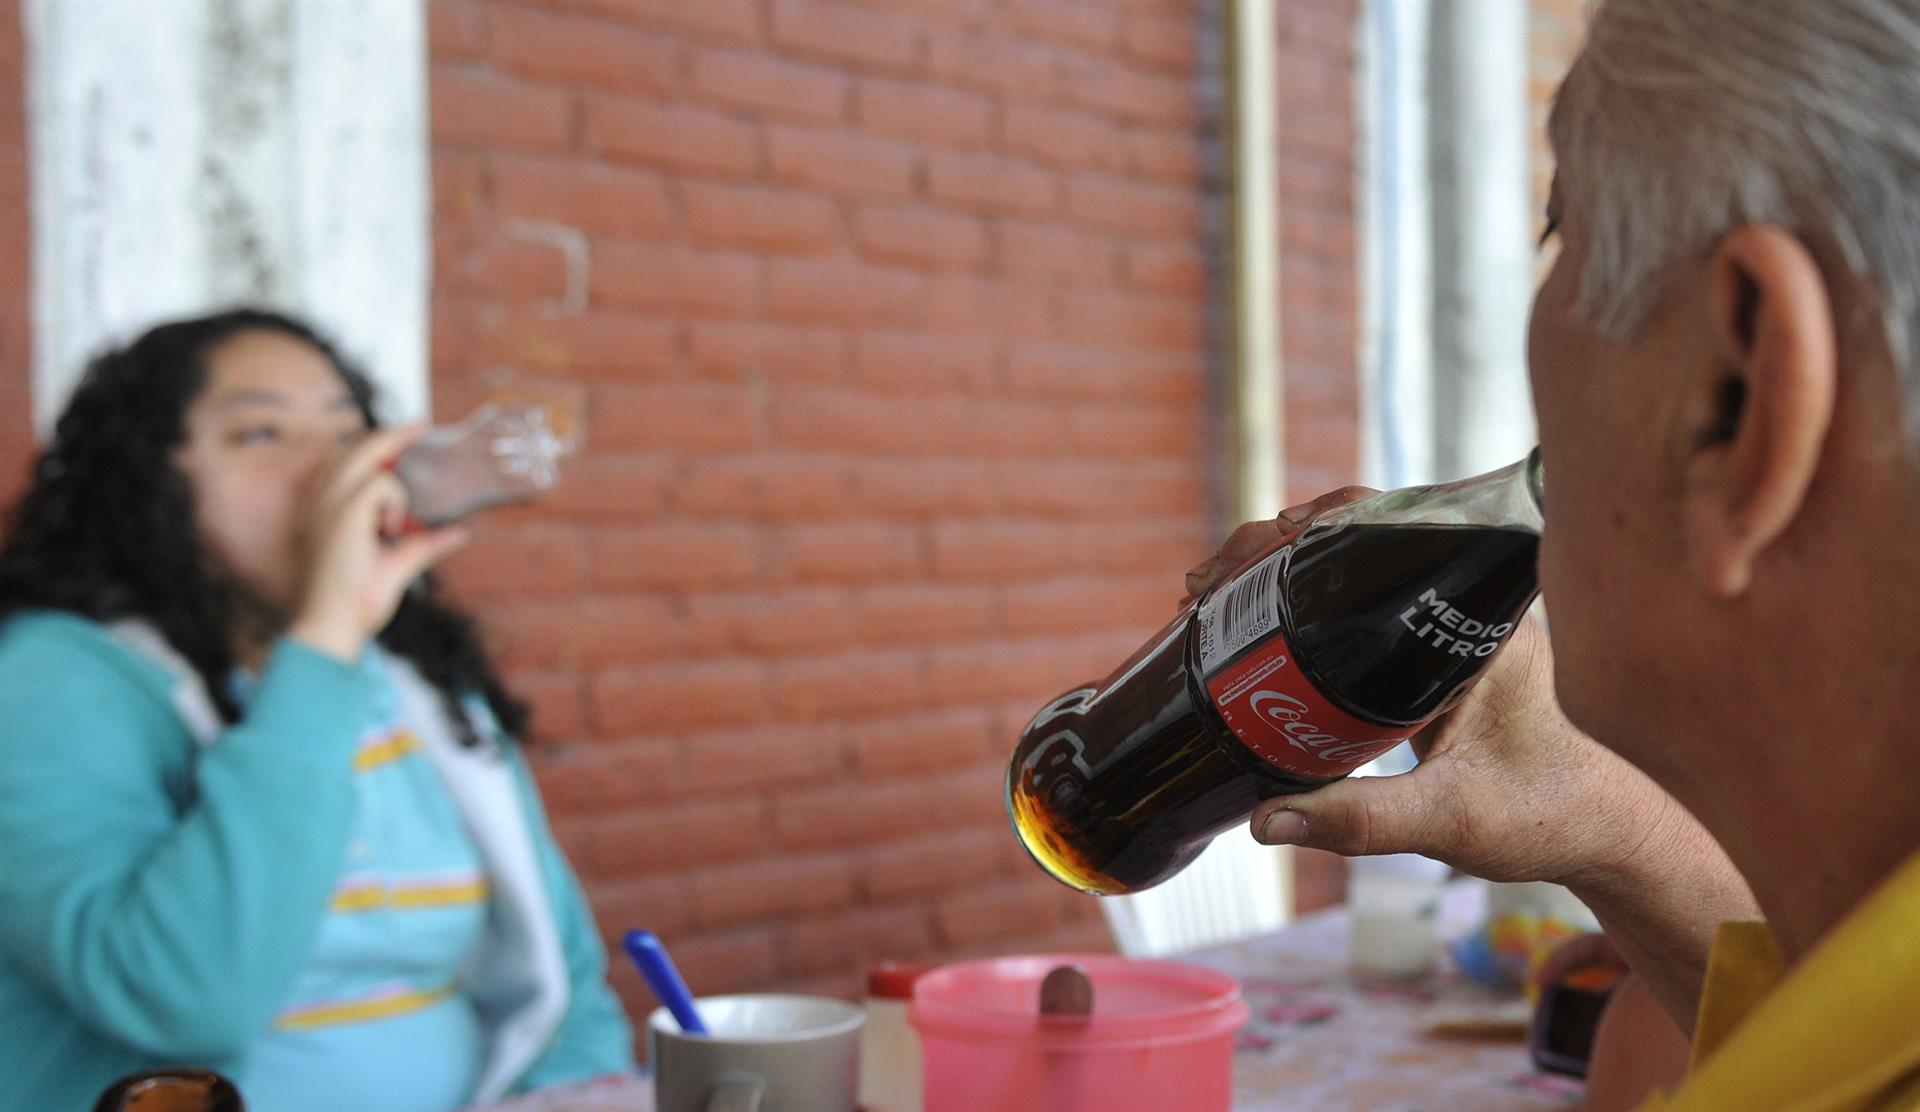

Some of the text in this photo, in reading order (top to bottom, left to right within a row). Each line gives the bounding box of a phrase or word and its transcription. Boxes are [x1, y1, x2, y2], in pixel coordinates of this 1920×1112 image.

[1248, 619, 1269, 637] 4699
[1400, 605, 1498, 657] LITRO
[1418, 587, 1513, 639] MEDIO
